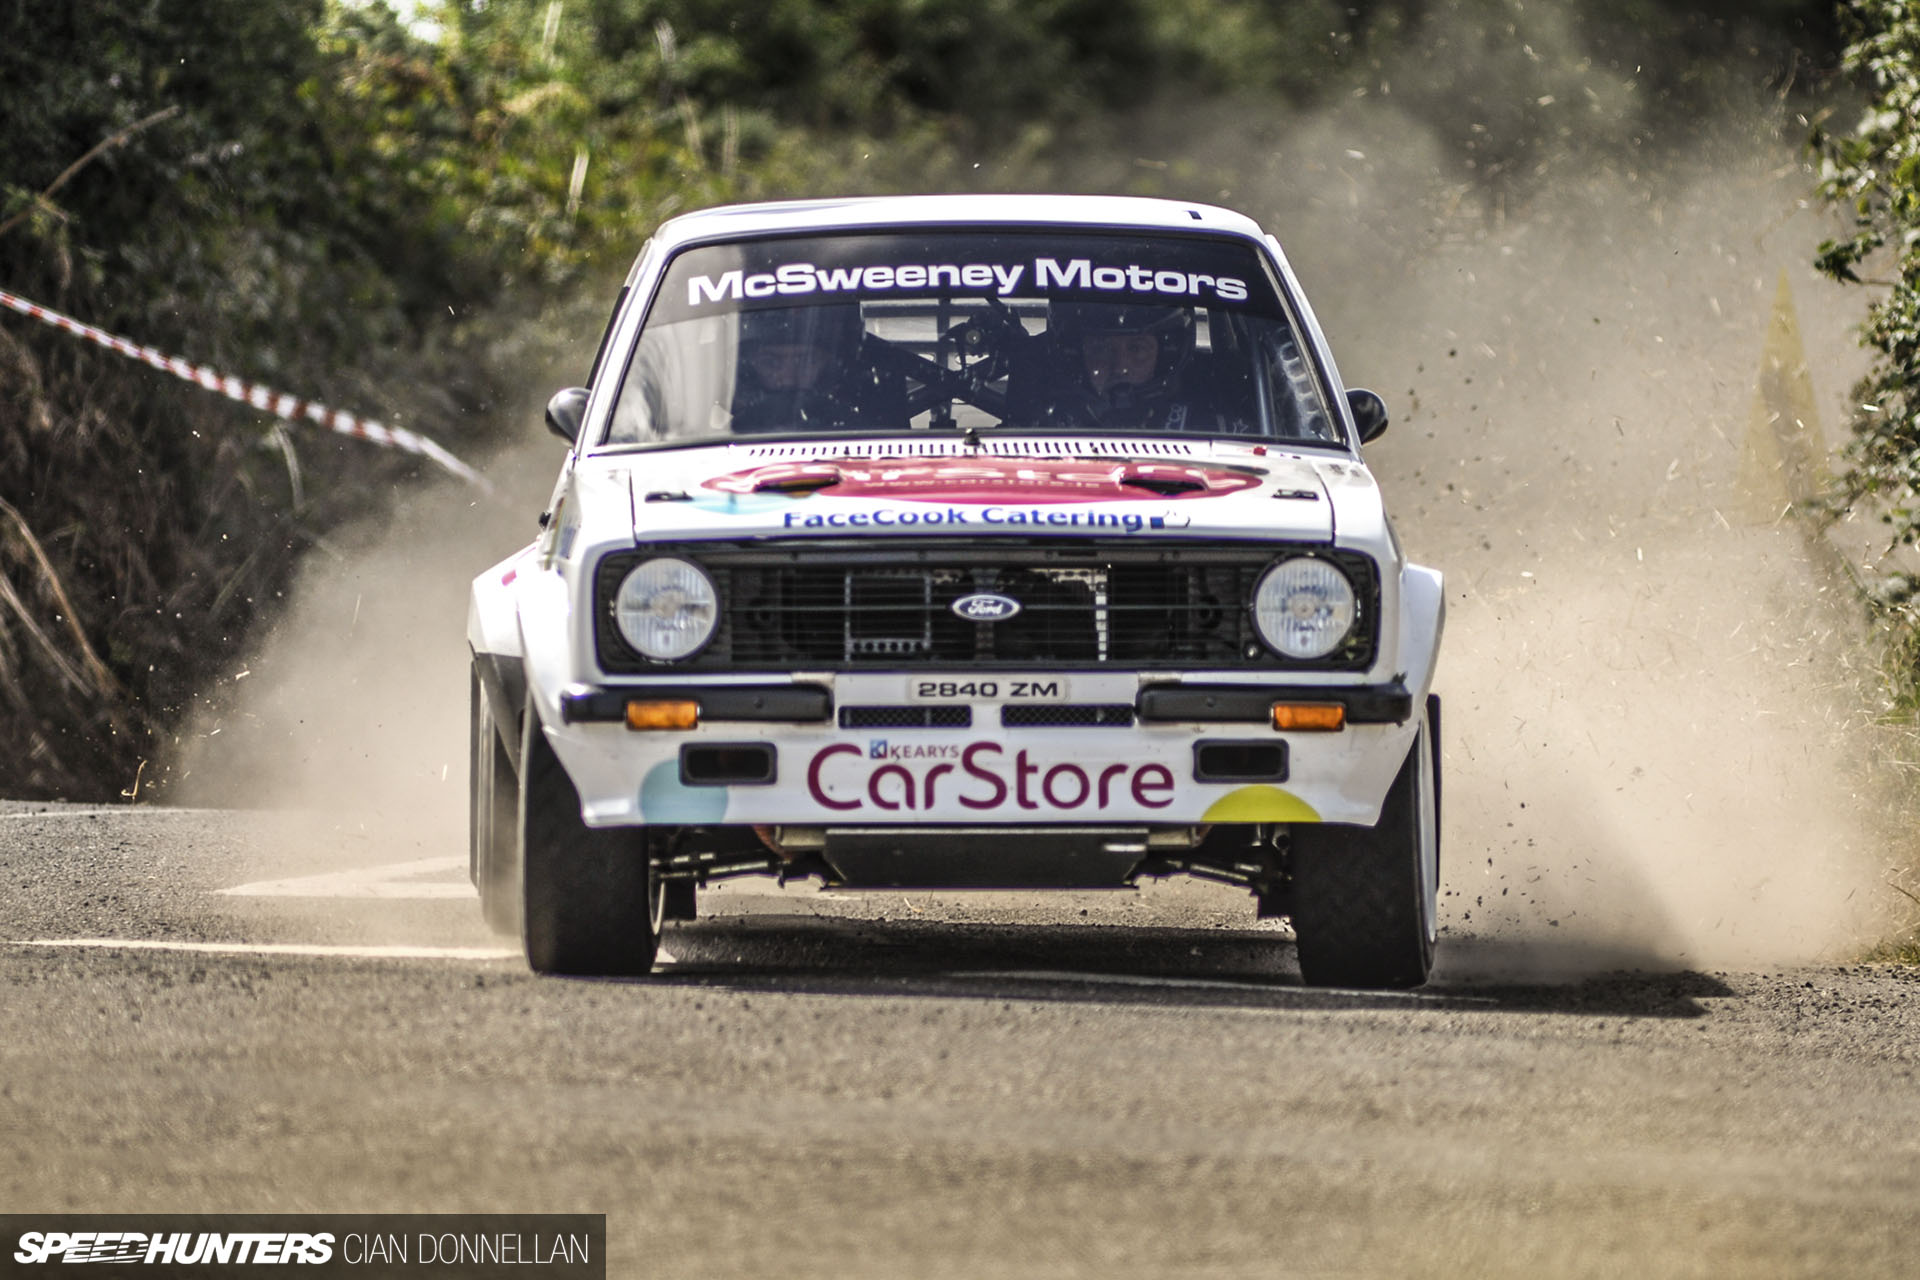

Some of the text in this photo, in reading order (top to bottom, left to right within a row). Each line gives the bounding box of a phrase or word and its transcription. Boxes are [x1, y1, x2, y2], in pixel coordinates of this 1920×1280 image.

[688, 257, 1248, 306] McSweeney Motors
[784, 507, 1144, 533] FaceCook Catering
[967, 599, 1003, 615] Ford
[919, 682, 1058, 697] 2840 ZM
[890, 744, 959, 759] KEARYS
[807, 741, 1175, 811] CarStore
